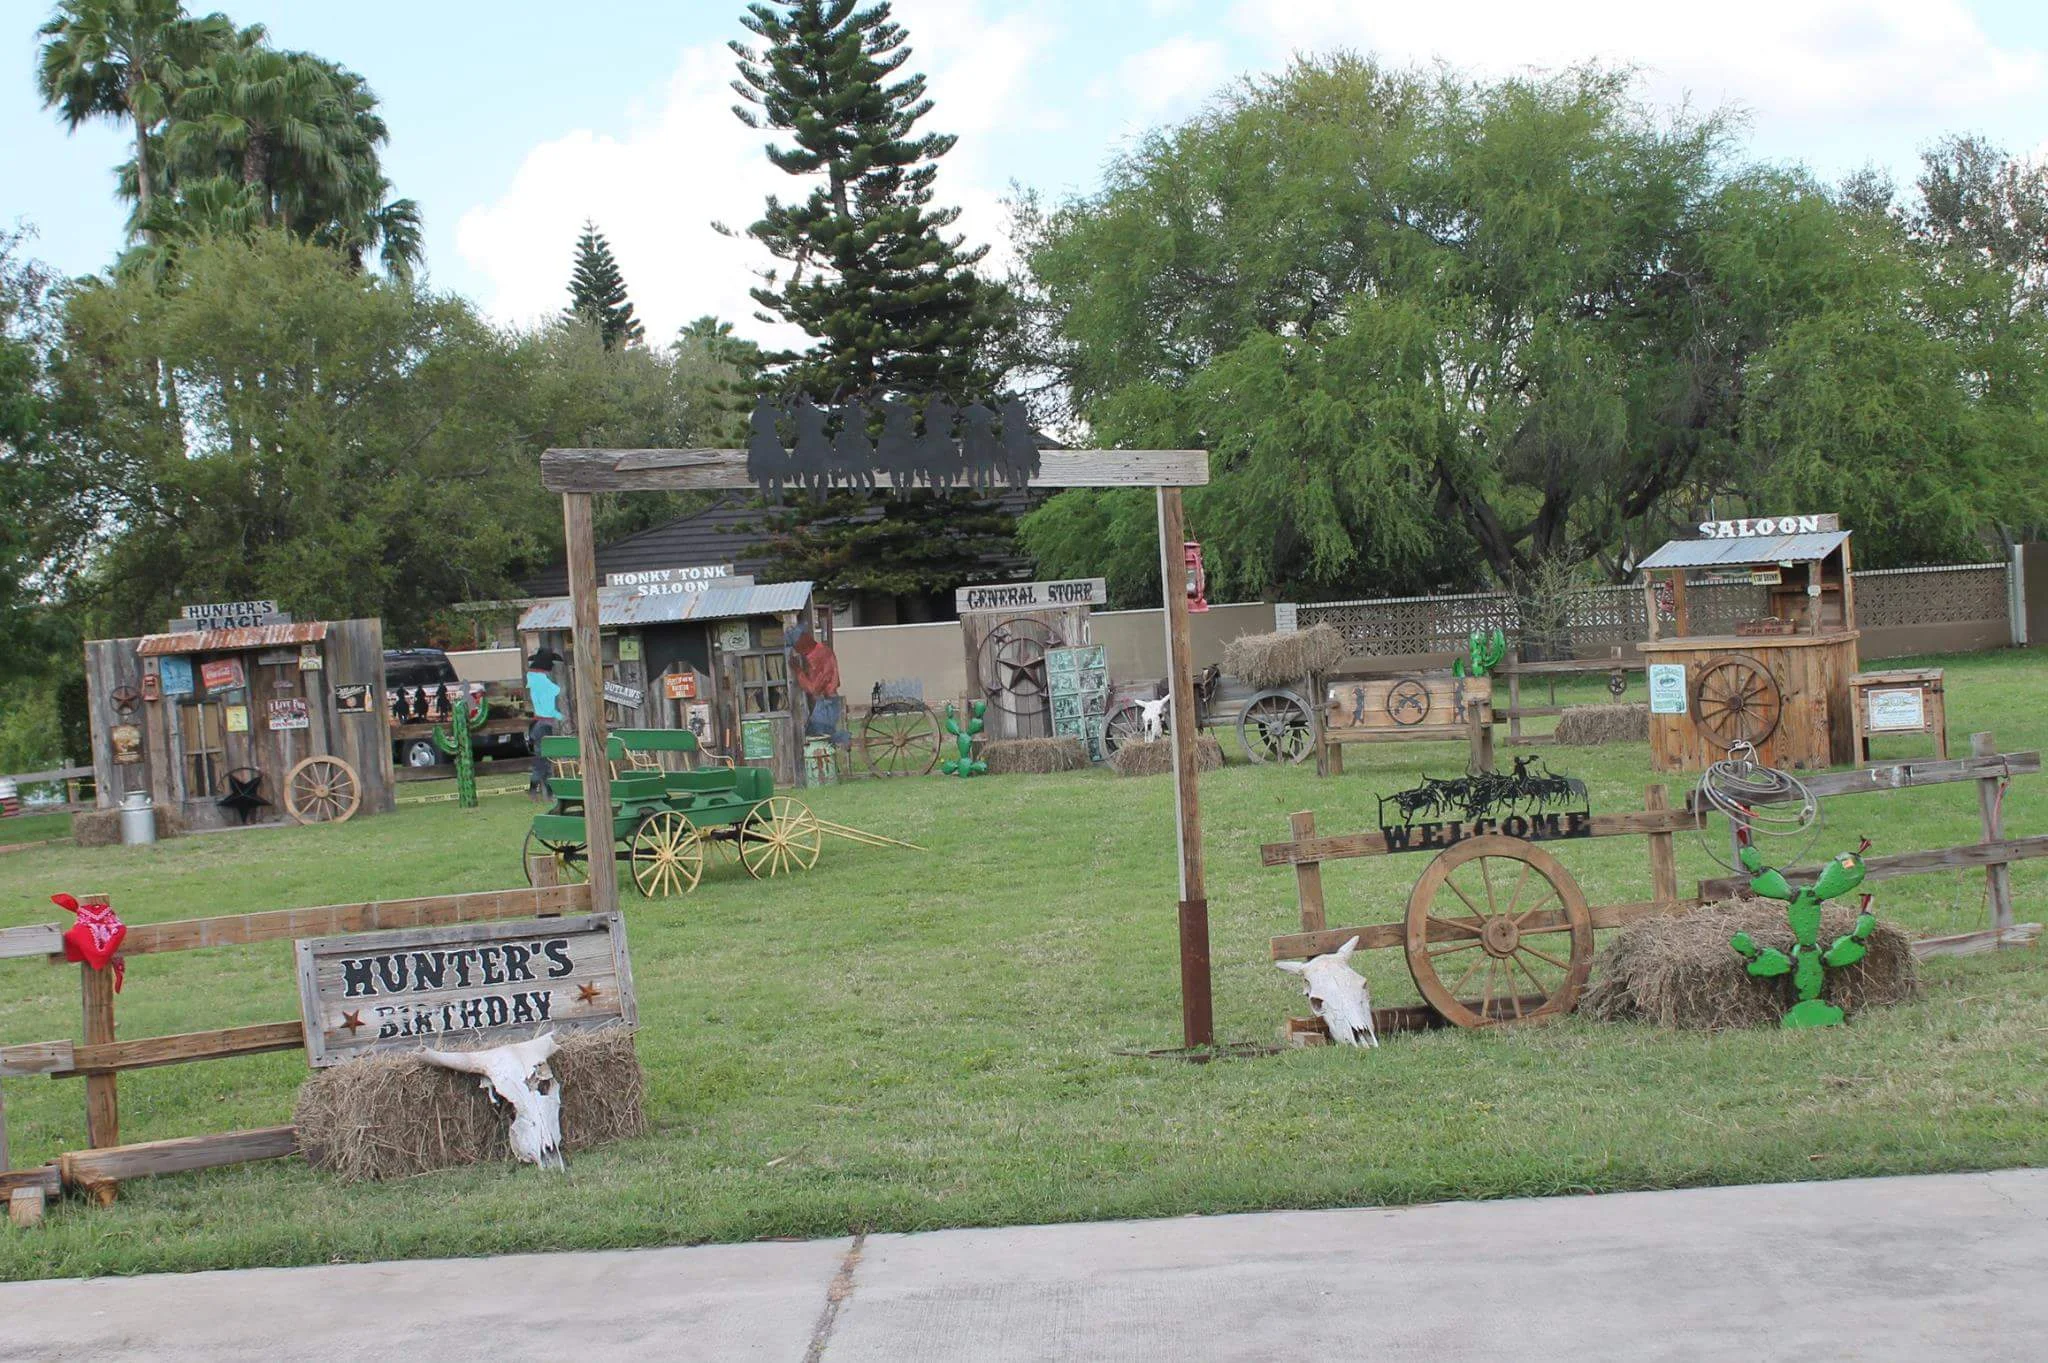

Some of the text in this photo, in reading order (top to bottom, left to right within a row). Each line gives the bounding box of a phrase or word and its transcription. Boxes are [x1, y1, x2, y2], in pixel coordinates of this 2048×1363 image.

[1698, 515, 1819, 538] SALOON
[613, 565, 727, 586] HONKY TONK
[637, 580, 710, 596] SALOON
[967, 582, 1093, 609] GENERAL STORE
[188, 600, 273, 619] HUNTER'S
[603, 680, 641, 699] OUTLAWS
[1382, 811, 1590, 854] WELCOME
[340, 938, 576, 998] HUNTER'S
[374, 990, 554, 1040] BIRTHDAY
